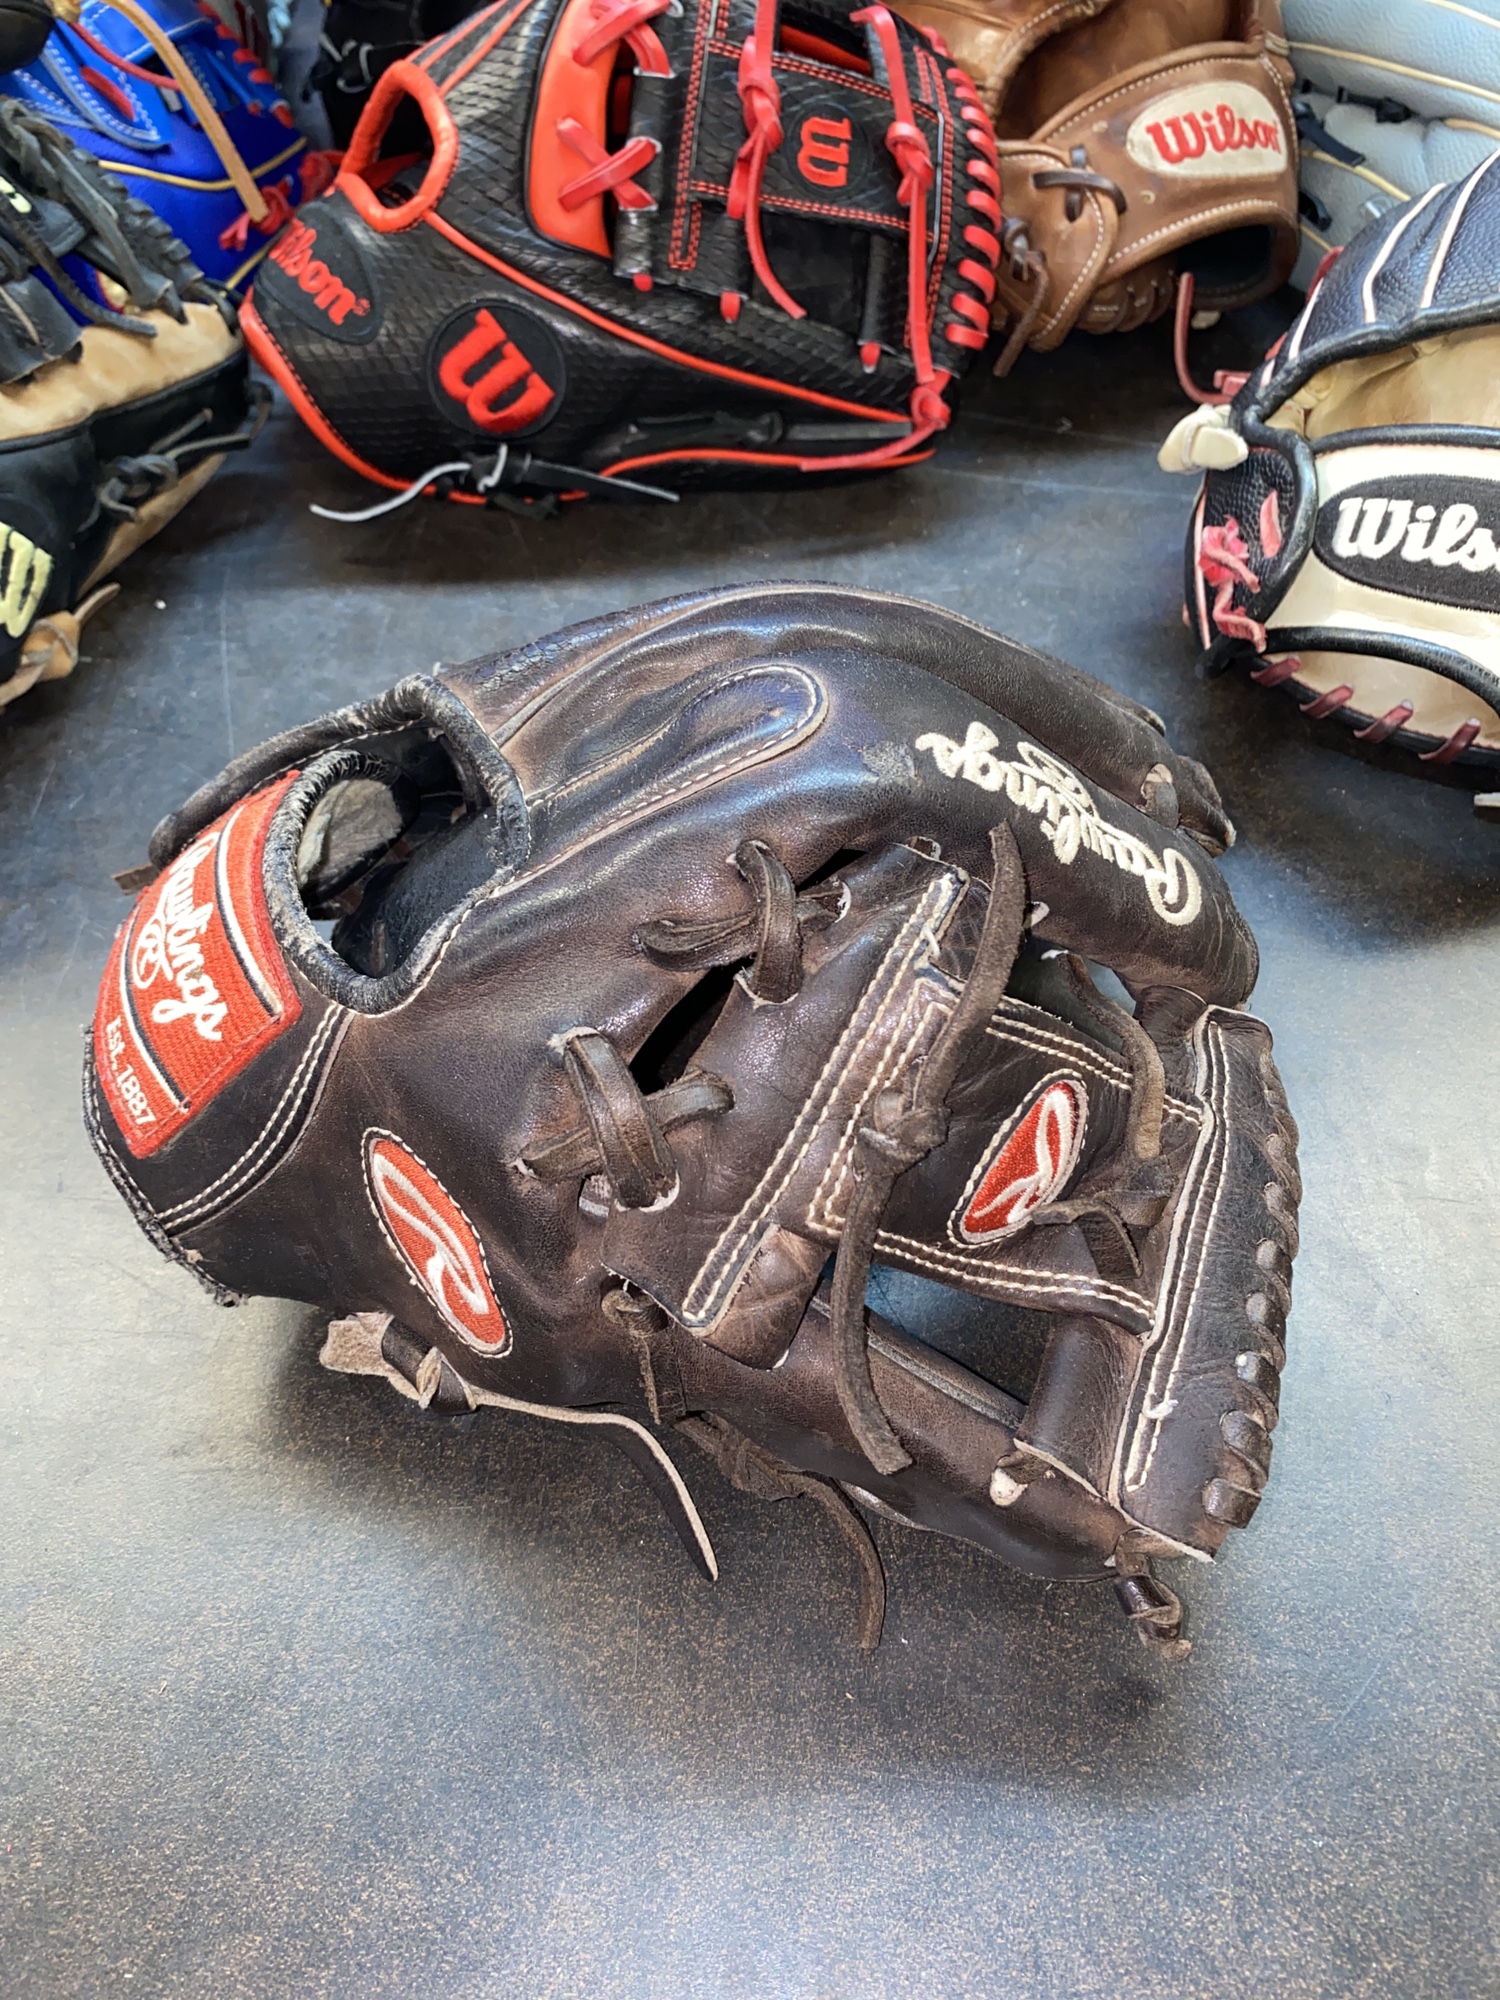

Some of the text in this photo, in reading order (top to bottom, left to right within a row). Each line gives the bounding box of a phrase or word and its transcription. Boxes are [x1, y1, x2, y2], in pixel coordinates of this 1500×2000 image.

[1332, 497, 1500, 573] Wils
[915, 721, 1202, 927] Rawlings
[133, 831, 228, 1041] Rawlings
[114, 1067, 158, 1126] 1887
